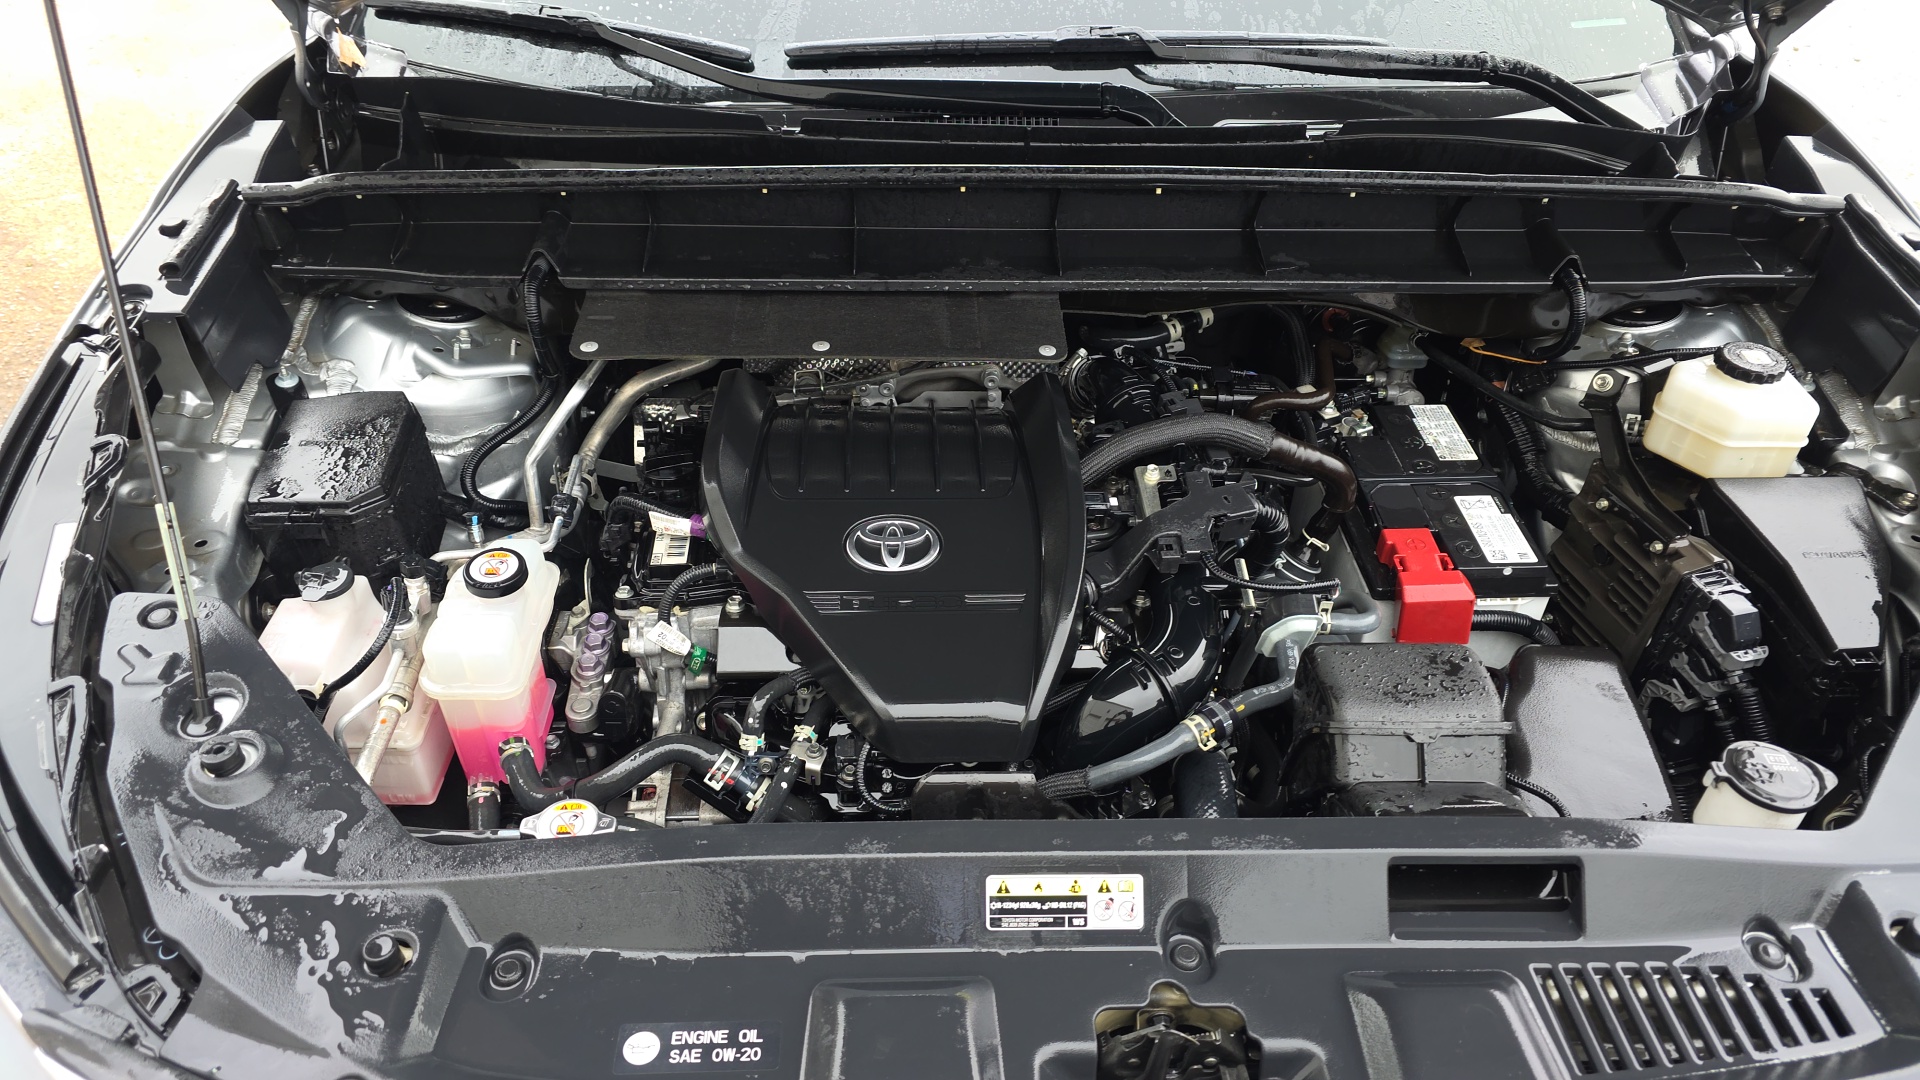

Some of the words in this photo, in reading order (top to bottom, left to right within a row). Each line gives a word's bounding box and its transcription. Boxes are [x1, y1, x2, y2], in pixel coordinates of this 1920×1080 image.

[670, 1030, 729, 1045] ENGINE
[738, 1029, 763, 1043] OIL
[668, 1048, 702, 1064] SAE
[711, 1047, 762, 1063] 0W-20
